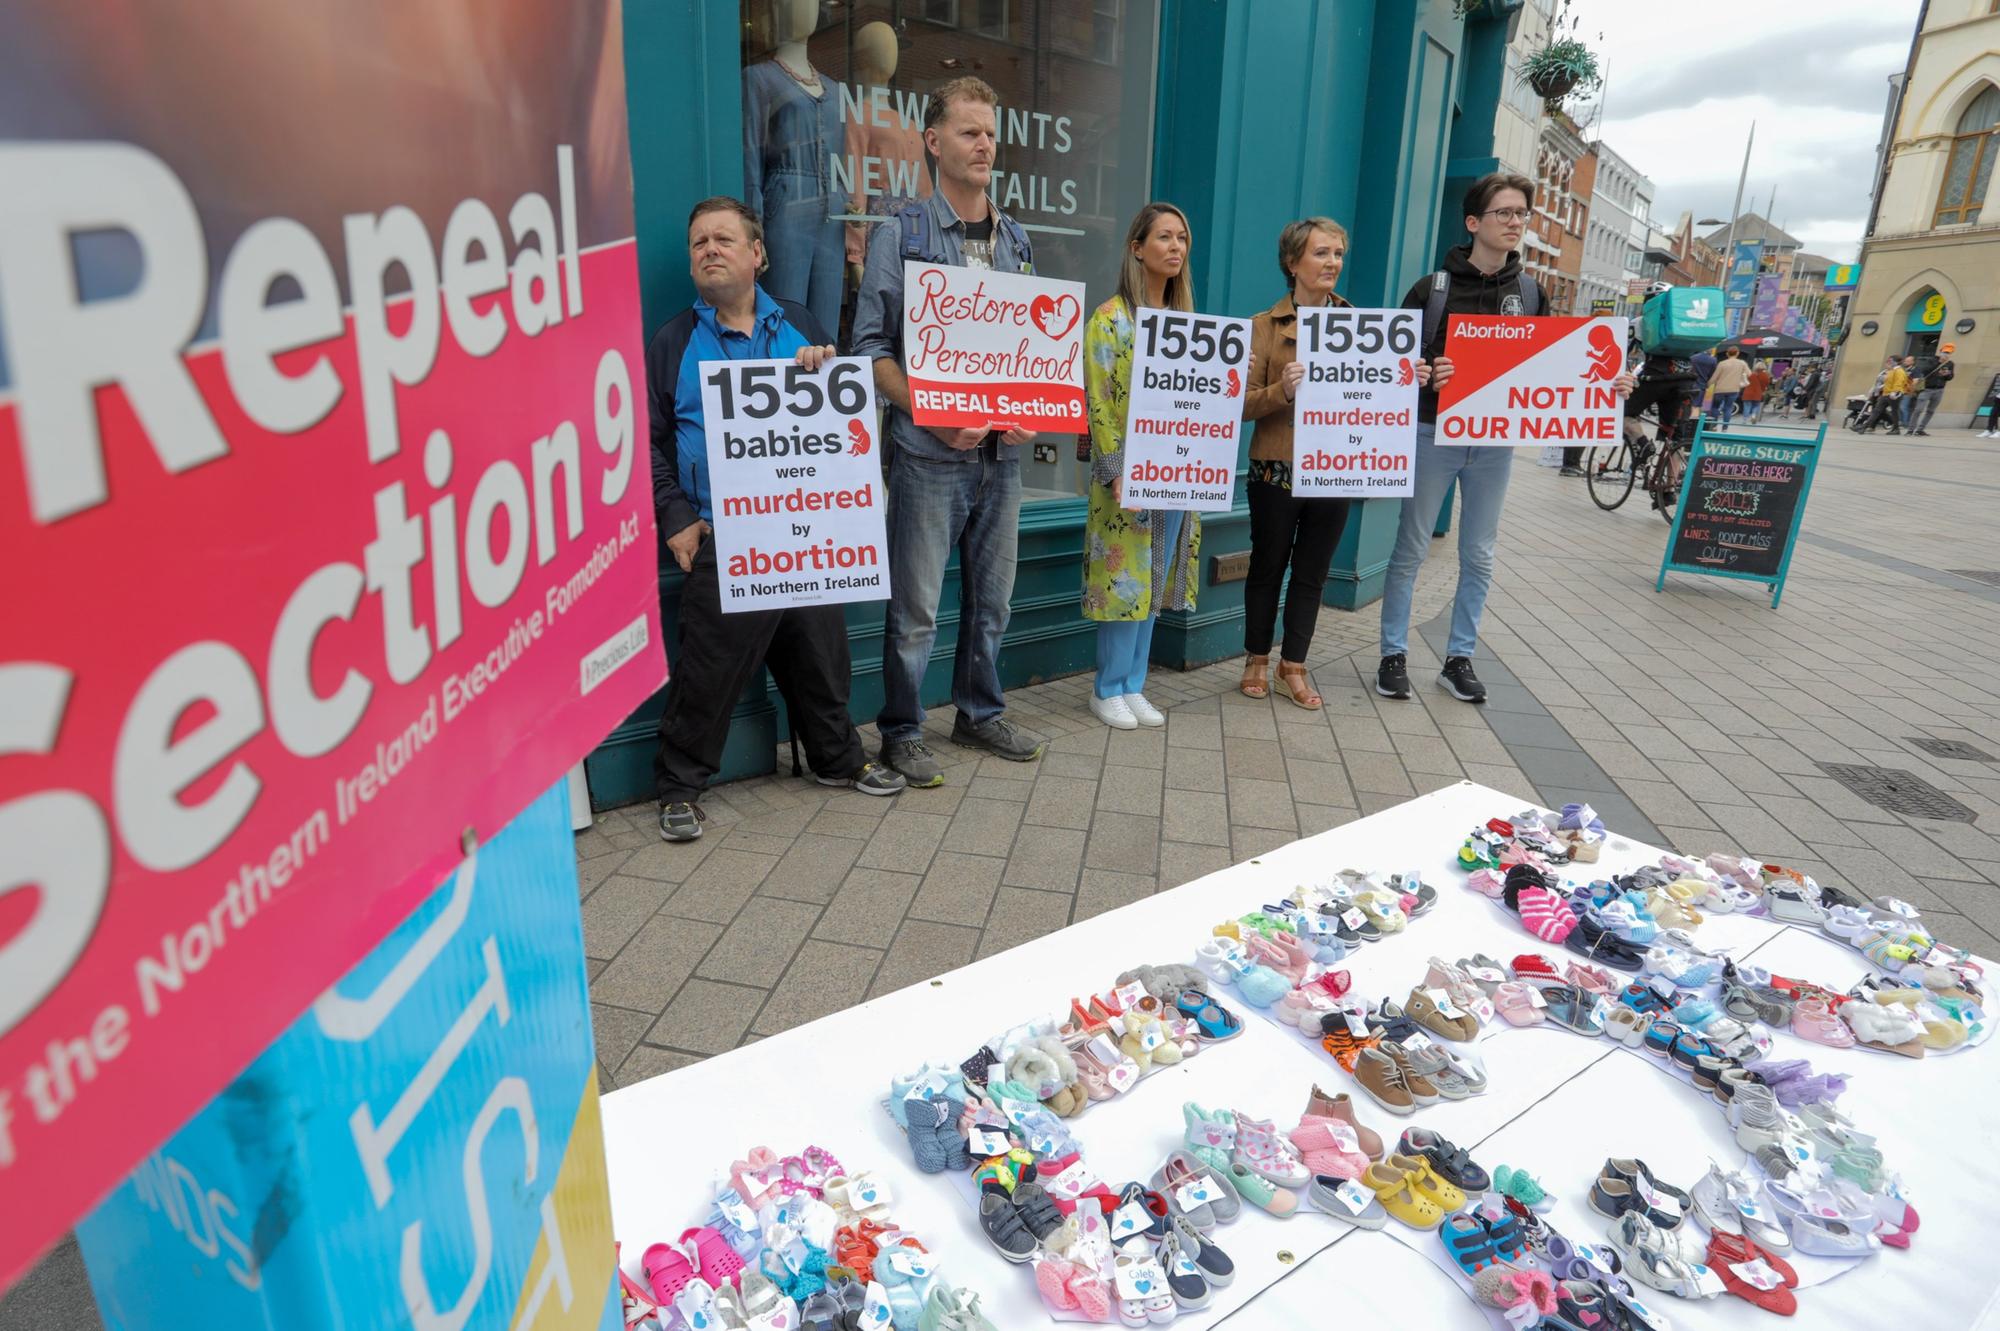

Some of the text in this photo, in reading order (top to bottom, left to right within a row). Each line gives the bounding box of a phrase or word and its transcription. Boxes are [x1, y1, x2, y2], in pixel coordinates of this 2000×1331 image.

[839, 82, 1072, 153] NEW INTS
[830, 153, 920, 199] NEW
[909, 269, 1028, 326] Restore
[0, 140, 584, 525] Repeal
[1141, 314, 1245, 365] 1556
[1303, 313, 1416, 355] 1556
[1453, 321, 1536, 339] Abortion?
[910, 324, 1079, 382] Personhood
[1143, 366, 1221, 394] babies
[1309, 360, 1393, 383] babies
[707, 363, 867, 420] 1556
[1343, 391, 1372, 400] were
[1508, 387, 1616, 409] NOT IN
[914, 389, 1082, 419] REPEAL Section 9
[1174, 400, 1201, 410] were
[1135, 417, 1234, 439] murdered
[1303, 408, 1409, 426] murdered
[1443, 416, 1615, 440] OUR NAME
[724, 425, 842, 460] babies
[1176, 445, 1189, 457] by
[1349, 434, 1363, 444] by
[1301, 448, 1408, 471] abortion
[1702, 458, 1749, 475] SUMMER
[1762, 466, 1793, 481] HERE
[776, 466, 816, 479] were
[1130, 459, 1228, 485] abortion
[1301, 476, 1407, 487] in Northern Ireland
[1129, 487, 1227, 501] in Northern Ireland
[1700, 480, 1718, 489] AND
[723, 484, 873, 517] murdered
[792, 523, 811, 538] by
[728, 538, 877, 577] abortion
[1702, 545, 1731, 560] OUT
[731, 574, 880, 598] in Northern Ireland
[591, 640, 629, 682] Precious
[0, 349, 635, 1041] Section 9
[24, 1005, 130, 1123] the
[135, 808, 330, 1018] Northern
[335, 694, 437, 825] Ireland
[442, 610, 544, 722] Executive
[546, 536, 618, 626] Formation
[619, 511, 640, 553] Act
[1129, 1268, 1155, 1280] Caleb
